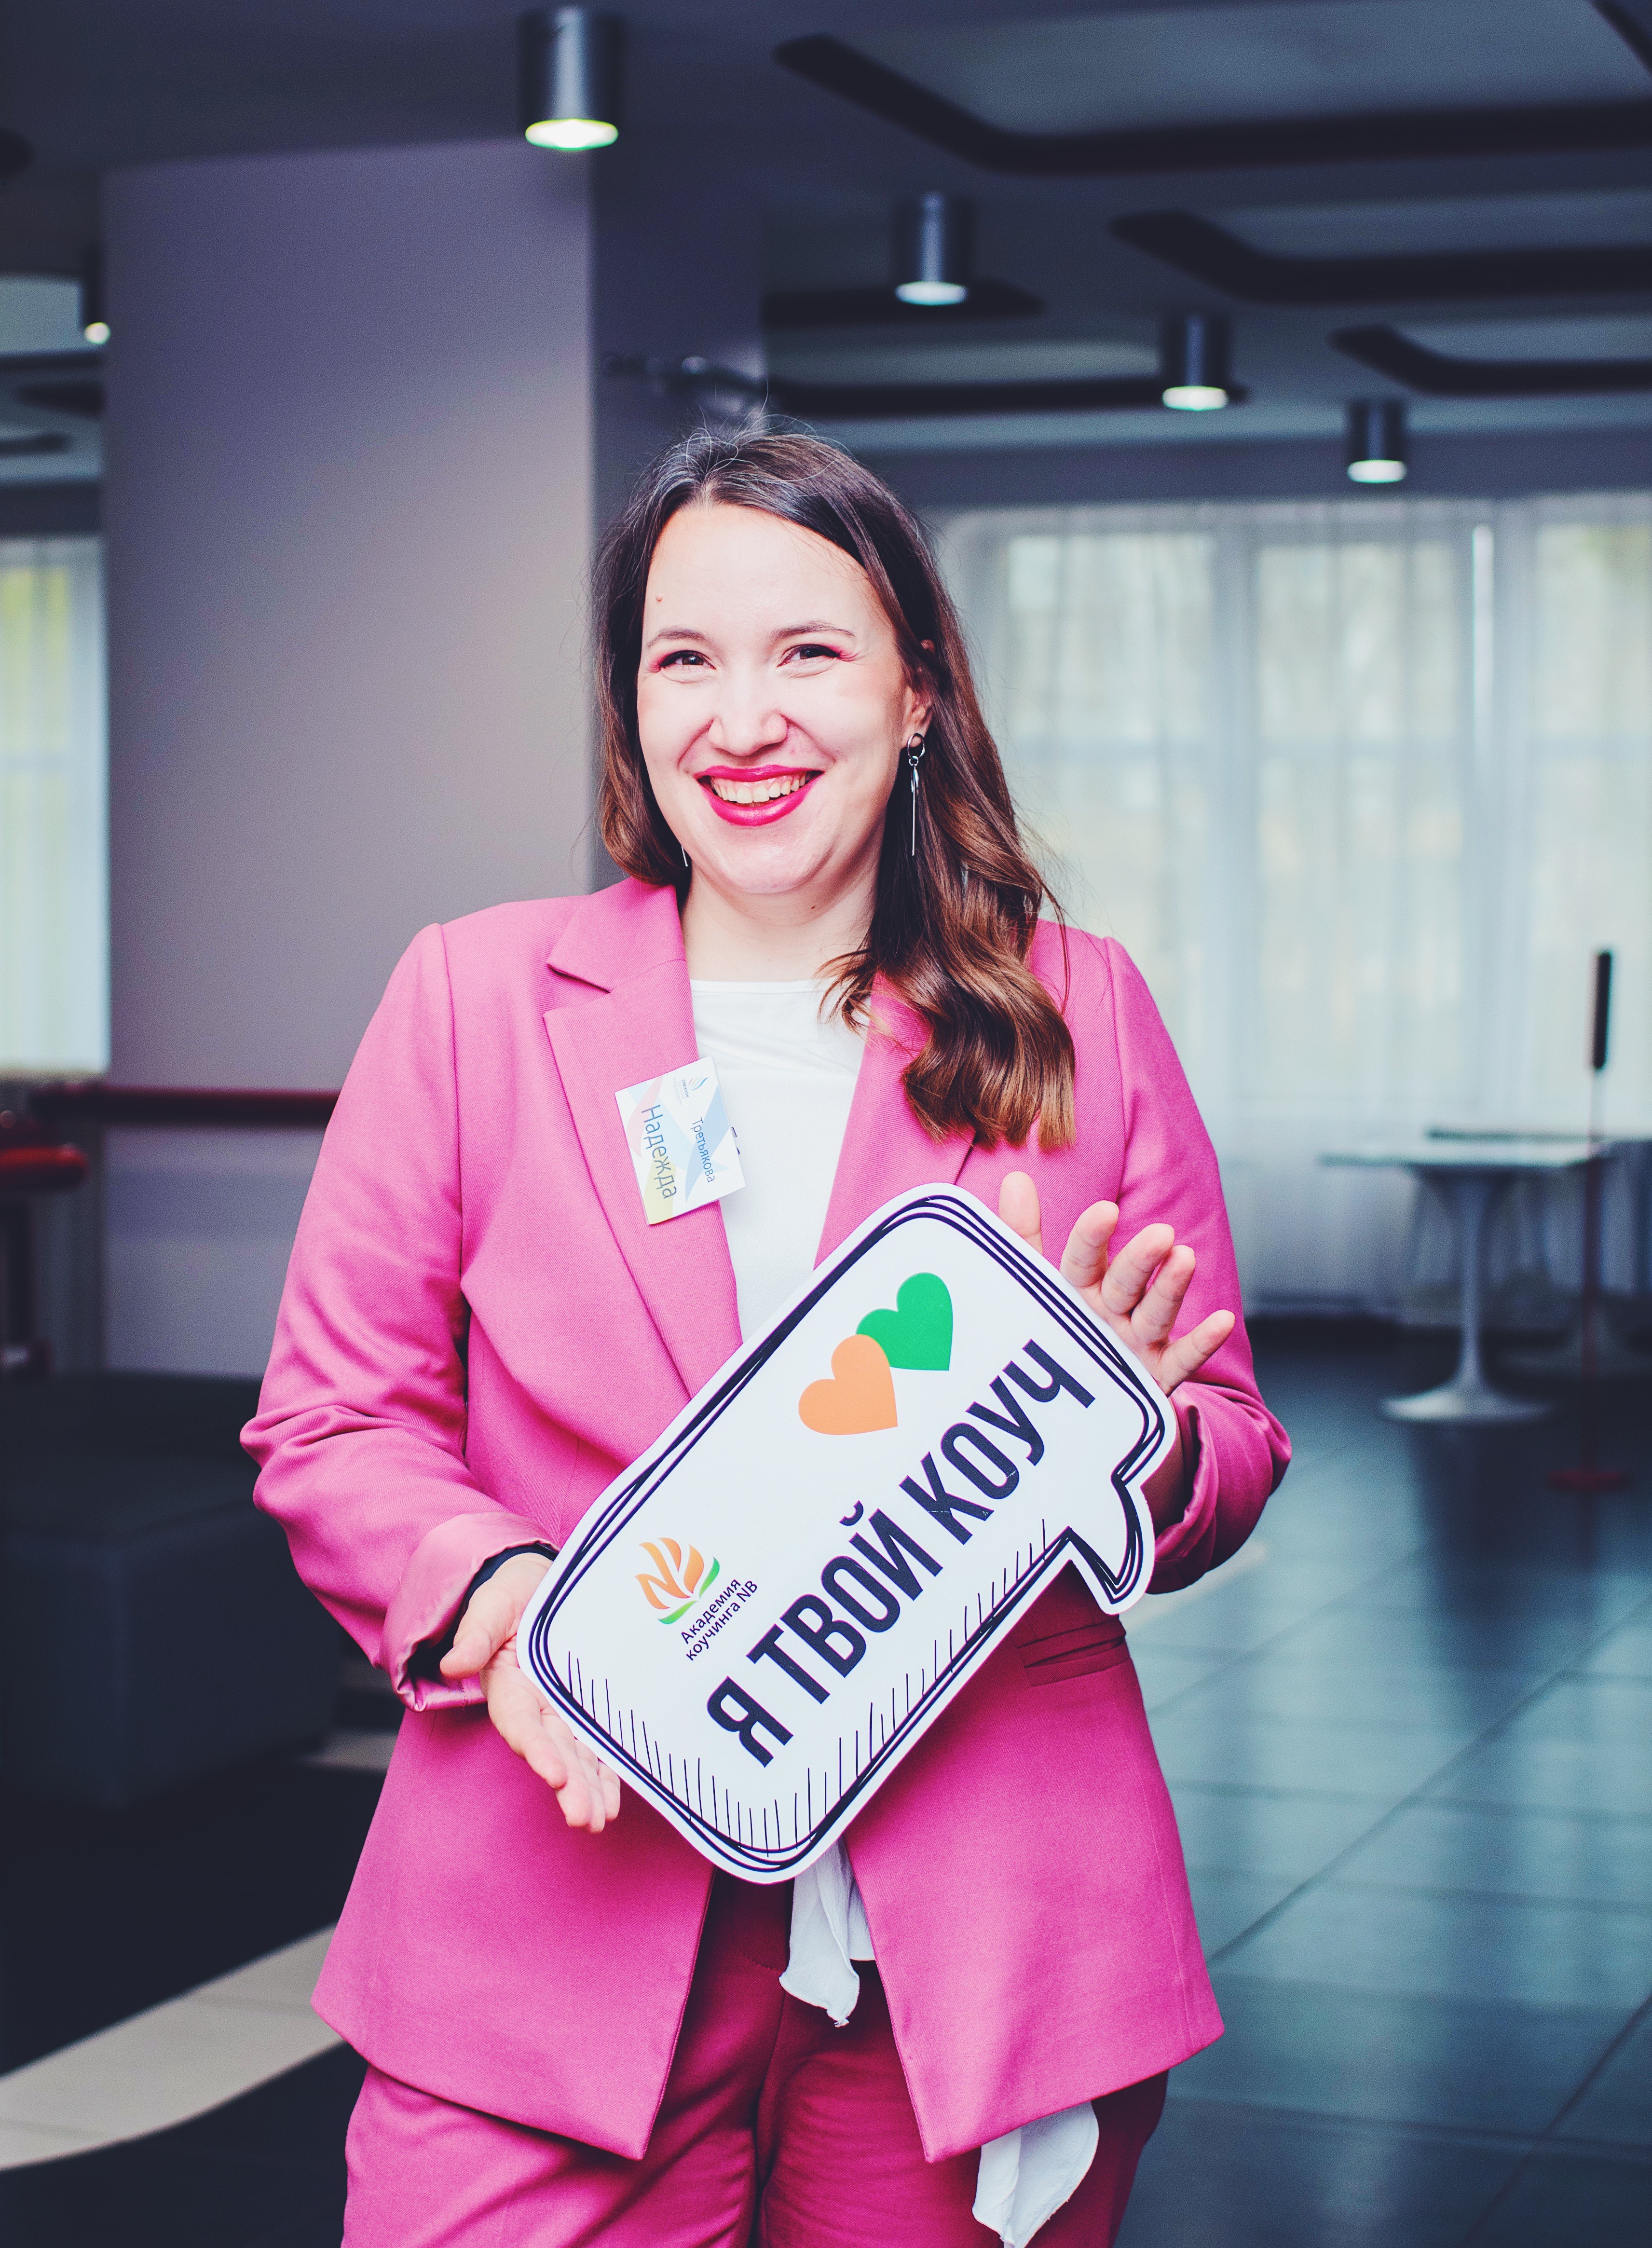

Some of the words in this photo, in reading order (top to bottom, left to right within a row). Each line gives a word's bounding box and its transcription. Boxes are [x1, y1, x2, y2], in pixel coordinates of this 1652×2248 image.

[641, 1105, 677, 1199] Надежда
[690, 1117, 715, 1182] Третьякова
[898, 1339, 1095, 1545] КОУЧ
[681, 1579, 741, 1645] Академия
[686, 1602, 741, 1661] коучинга
[736, 1580, 757, 1603] NB
[745, 1500, 943, 1705] ТВОЙ
[706, 1675, 794, 1768] Я
